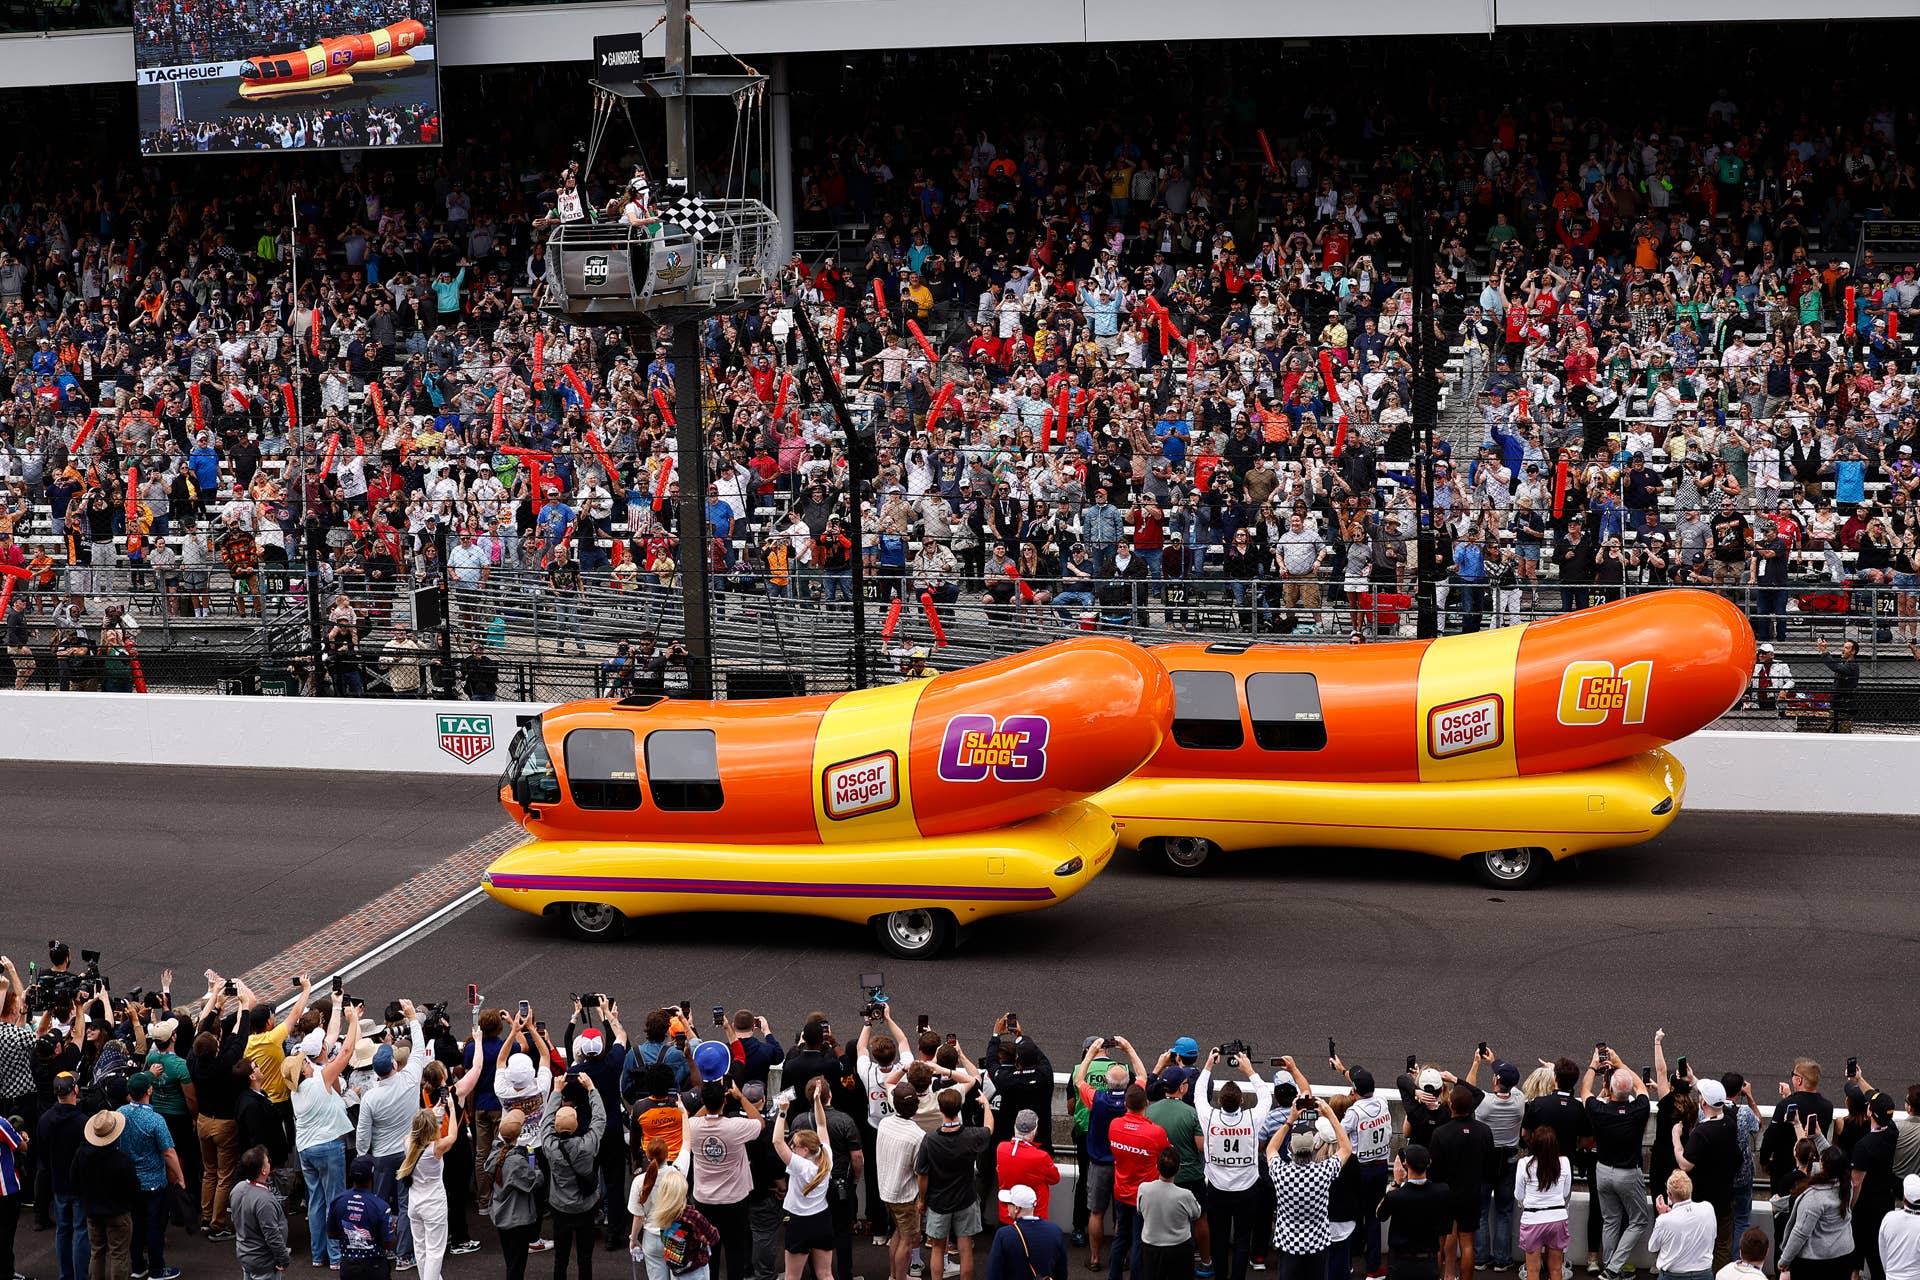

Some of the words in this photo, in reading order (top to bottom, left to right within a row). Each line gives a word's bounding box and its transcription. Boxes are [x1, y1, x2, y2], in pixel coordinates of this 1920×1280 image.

[608, 50, 640, 66] GAINBRIDGE
[584, 265, 608, 276] 500
[275, 579, 283, 591] 19
[868, 586, 877, 598] 21
[1174, 590, 1185, 602] 22
[1595, 595, 1606, 606] 23
[1883, 599, 1894, 612] 24
[1590, 678, 1622, 694] CHI
[1586, 693, 1624, 709] DOG
[442, 718, 487, 734] TAG
[1441, 707, 1489, 732] Oscar
[966, 732, 1020, 750] SLAW
[1440, 722, 1491, 746] Mayer
[442, 736, 491, 760] HEUER
[972, 749, 1012, 765] DOG
[837, 765, 885, 790] Oscar
[836, 780, 887, 805] Mayer
[1090, 1074, 1106, 1083] FO
[1360, 1113, 1391, 1131] Canon
[1210, 1126, 1252, 1136] Canon
[1373, 1127, 1385, 1144] 97
[1110, 1140, 1150, 1156] HONDA
[1223, 1138, 1240, 1153] 94
[1210, 1155, 1253, 1165] PHOTO
